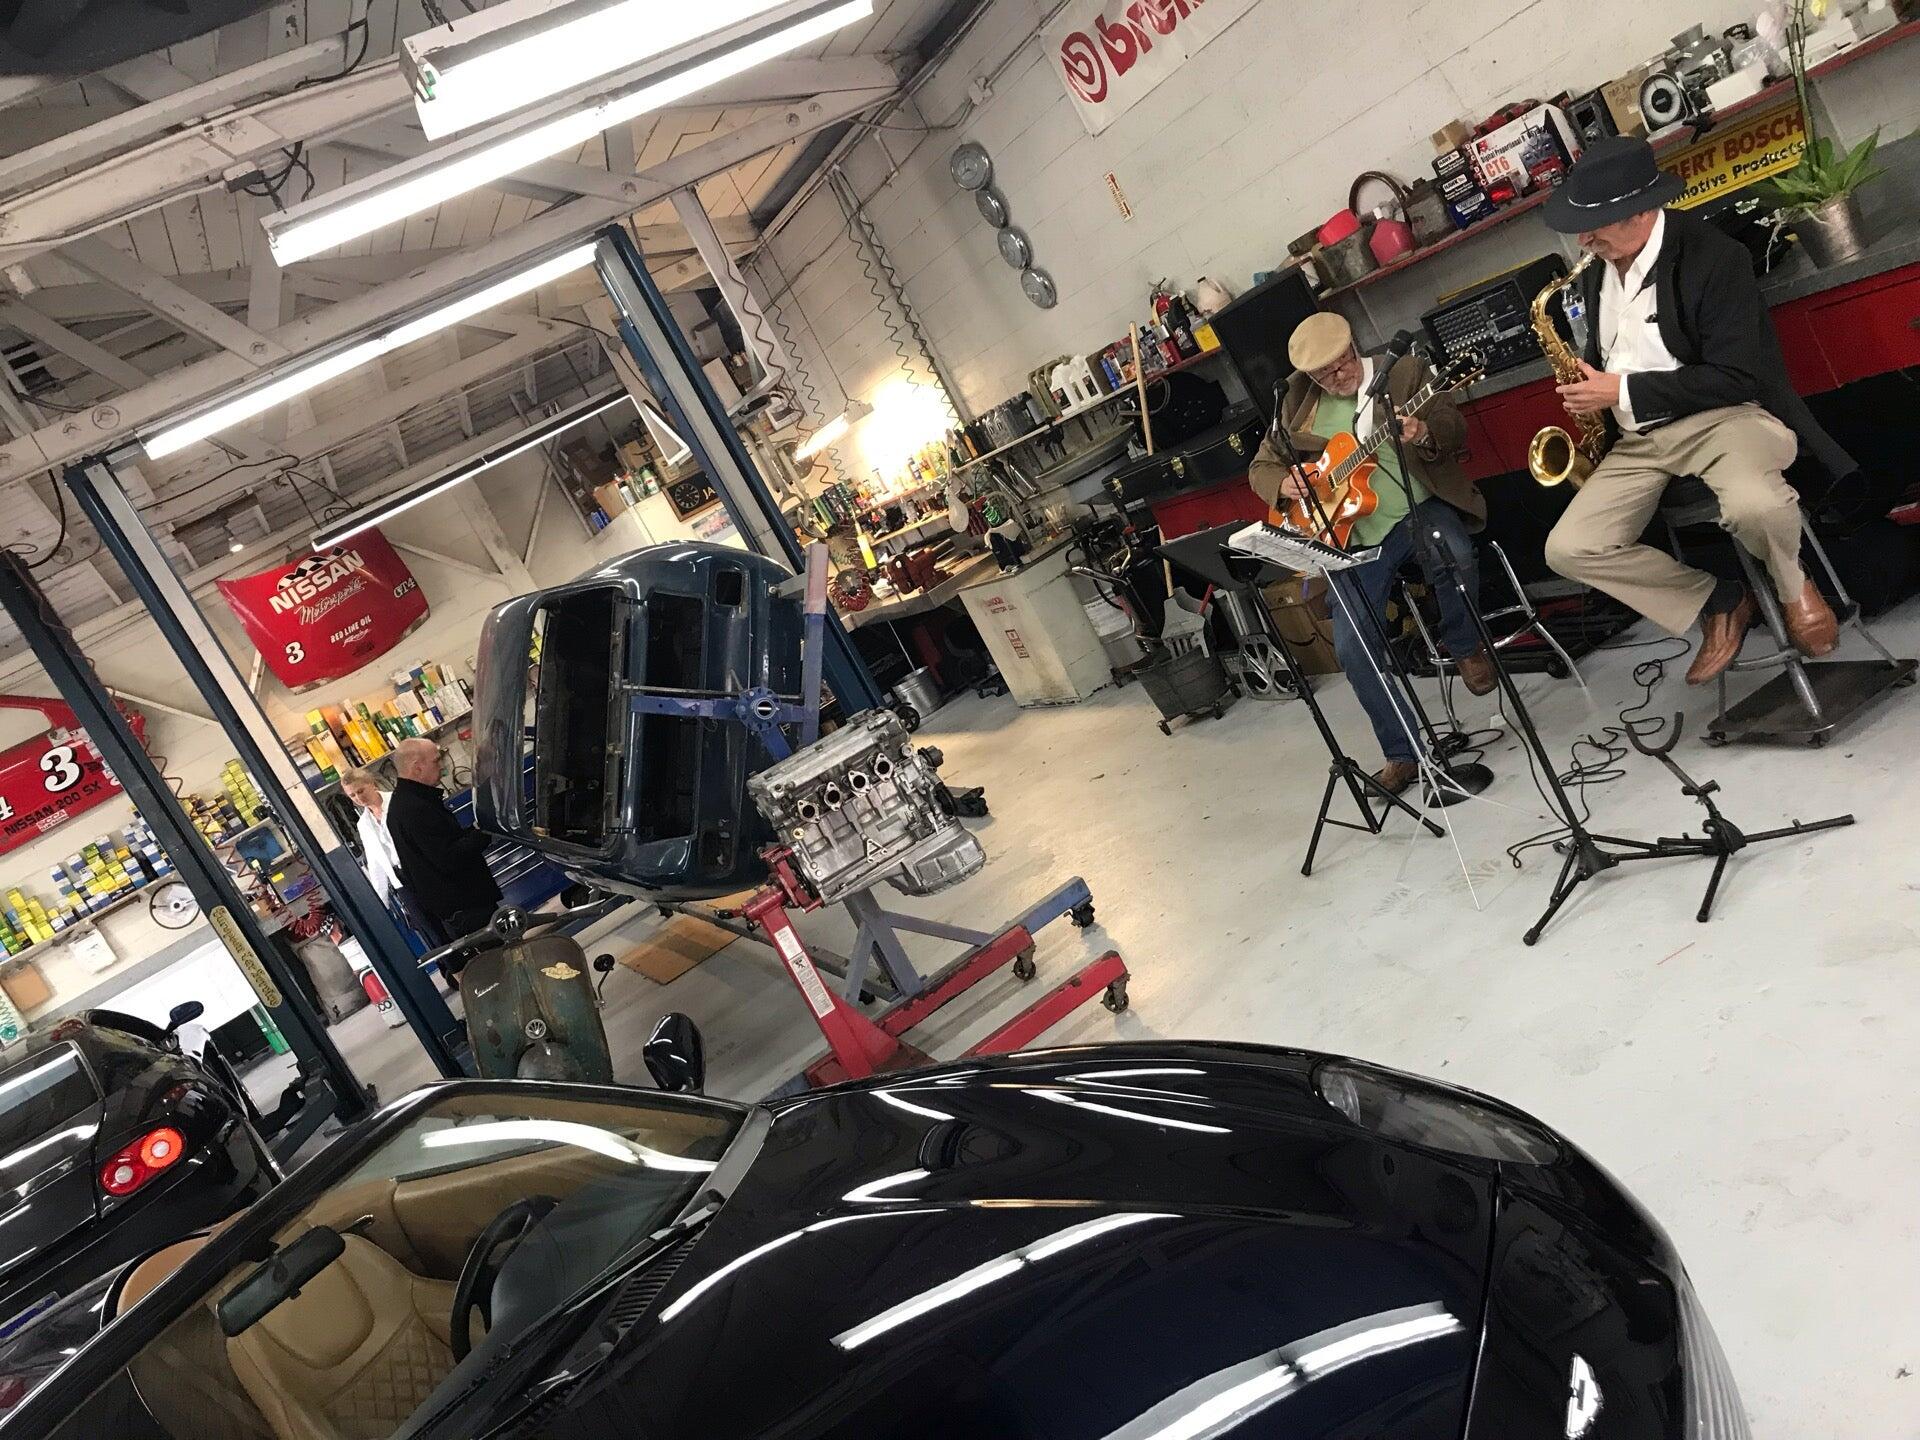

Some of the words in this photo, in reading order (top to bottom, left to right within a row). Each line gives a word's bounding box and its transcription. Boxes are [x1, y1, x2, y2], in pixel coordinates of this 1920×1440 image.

[1723, 112, 1805, 162] BOSCH
[1486, 156, 1510, 177] CT6
[1732, 140, 1806, 179] Products
[268, 549, 365, 614] NISSAN
[330, 631, 344, 644] RED
[344, 622, 360, 638] LINE
[360, 615, 372, 629] OIL
[285, 641, 305, 665] 3
[40, 746, 82, 792] 3
[4, 805, 54, 836] NISSAN
[56, 792, 81, 810] 200
[82, 781, 102, 796] SX
